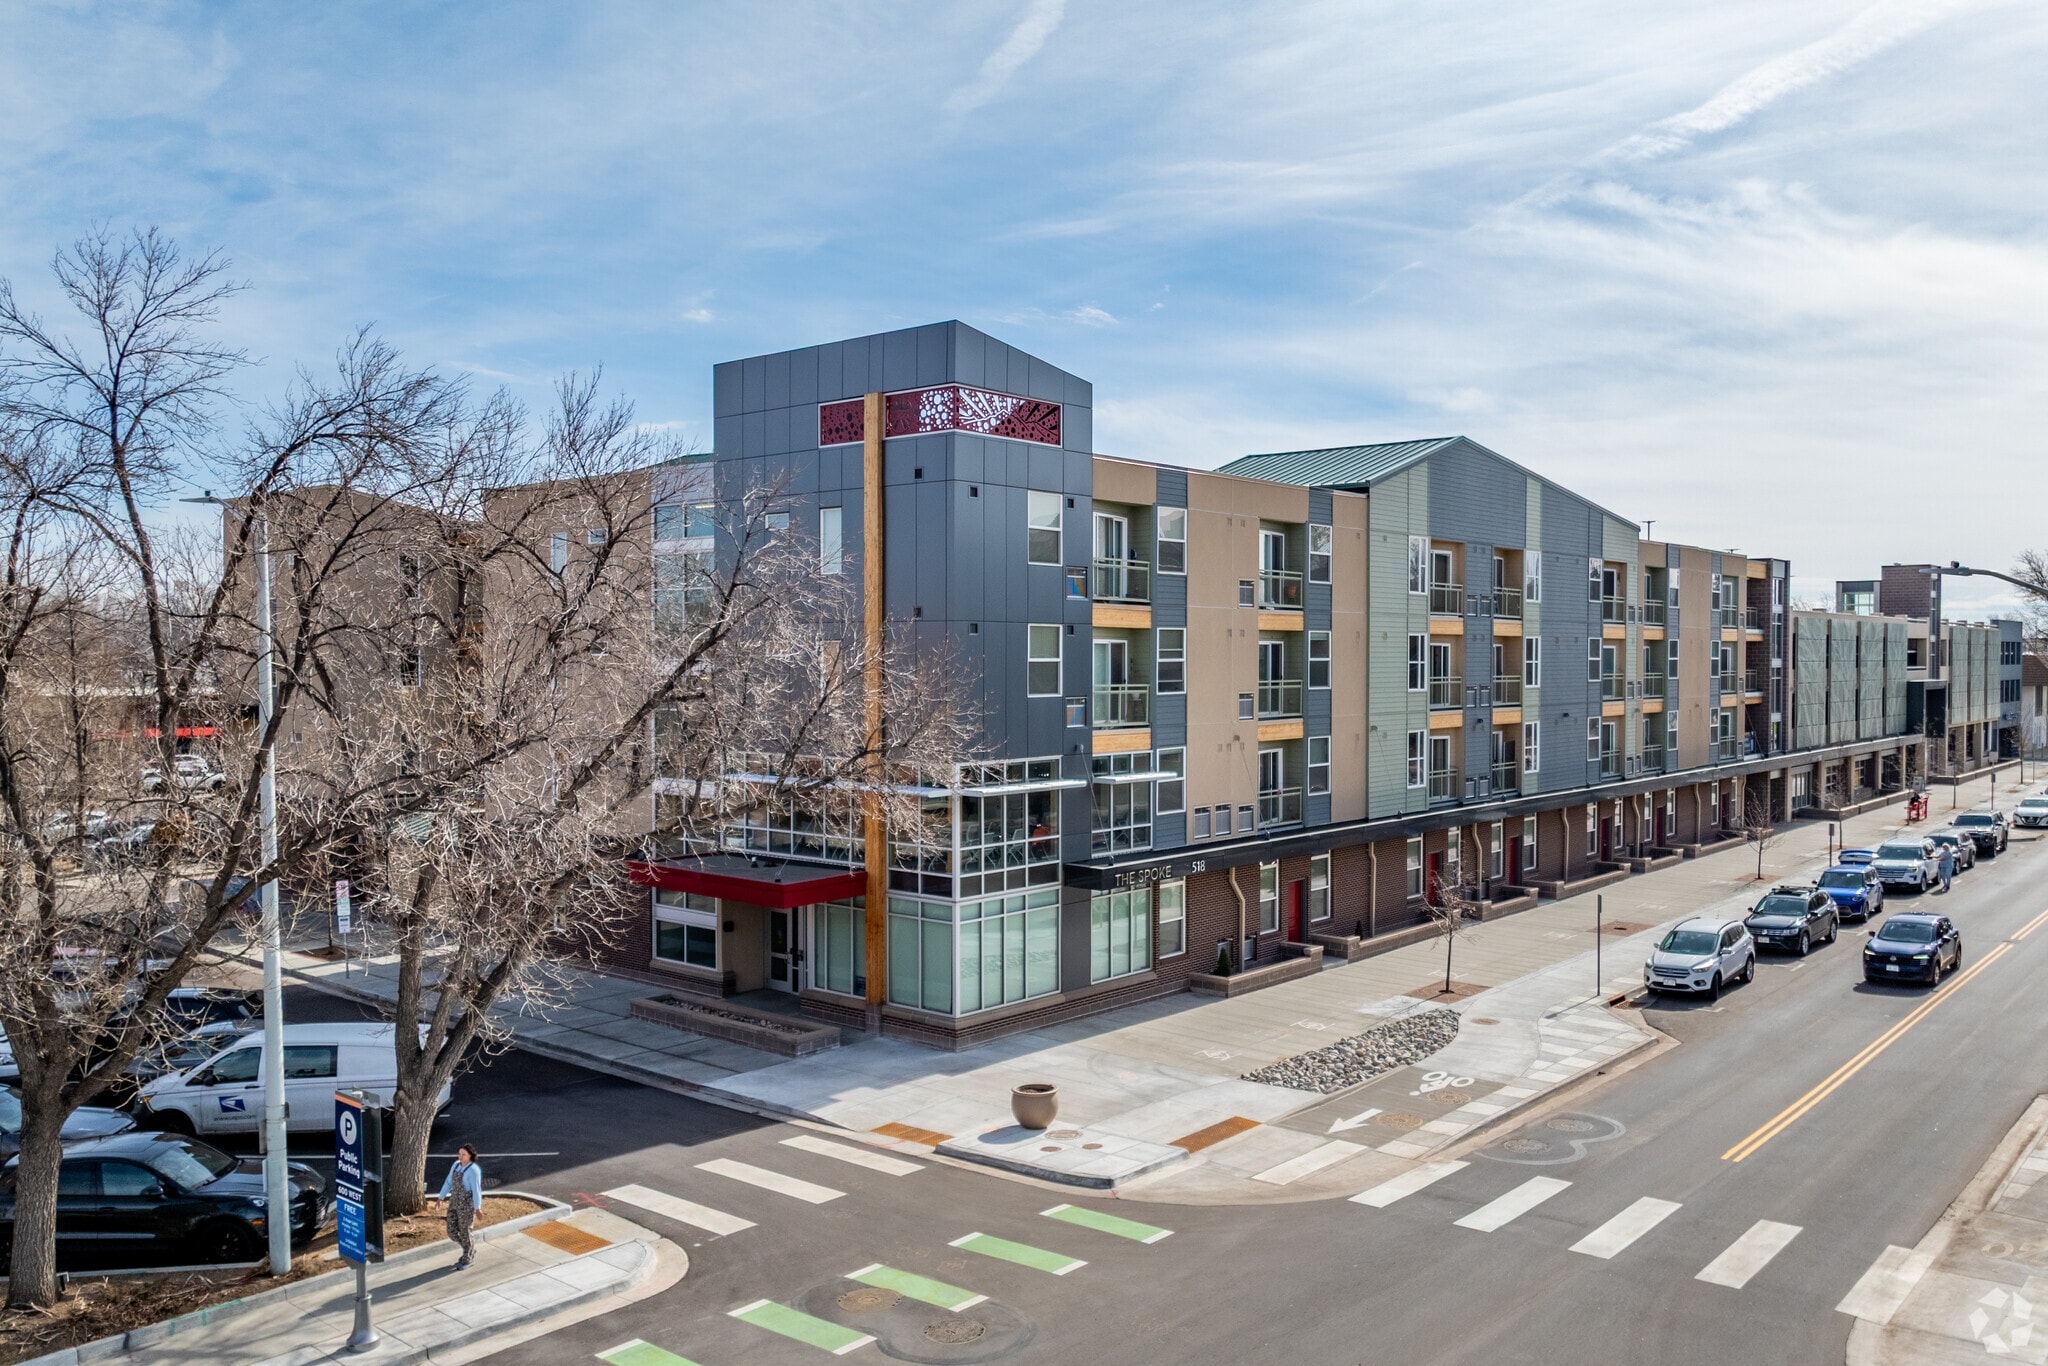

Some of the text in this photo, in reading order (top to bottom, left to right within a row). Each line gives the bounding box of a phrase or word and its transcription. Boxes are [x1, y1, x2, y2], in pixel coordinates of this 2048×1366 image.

[1191, 860, 1206, 873] 518
[1114, 865, 1172, 886] THE SPOKE
[344, 1117, 353, 1137] P
[340, 1148, 358, 1164] Public
[338, 1160, 360, 1179] Parking
[348, 1190, 362, 1201] WEST
[343, 1203, 357, 1215] FREE
